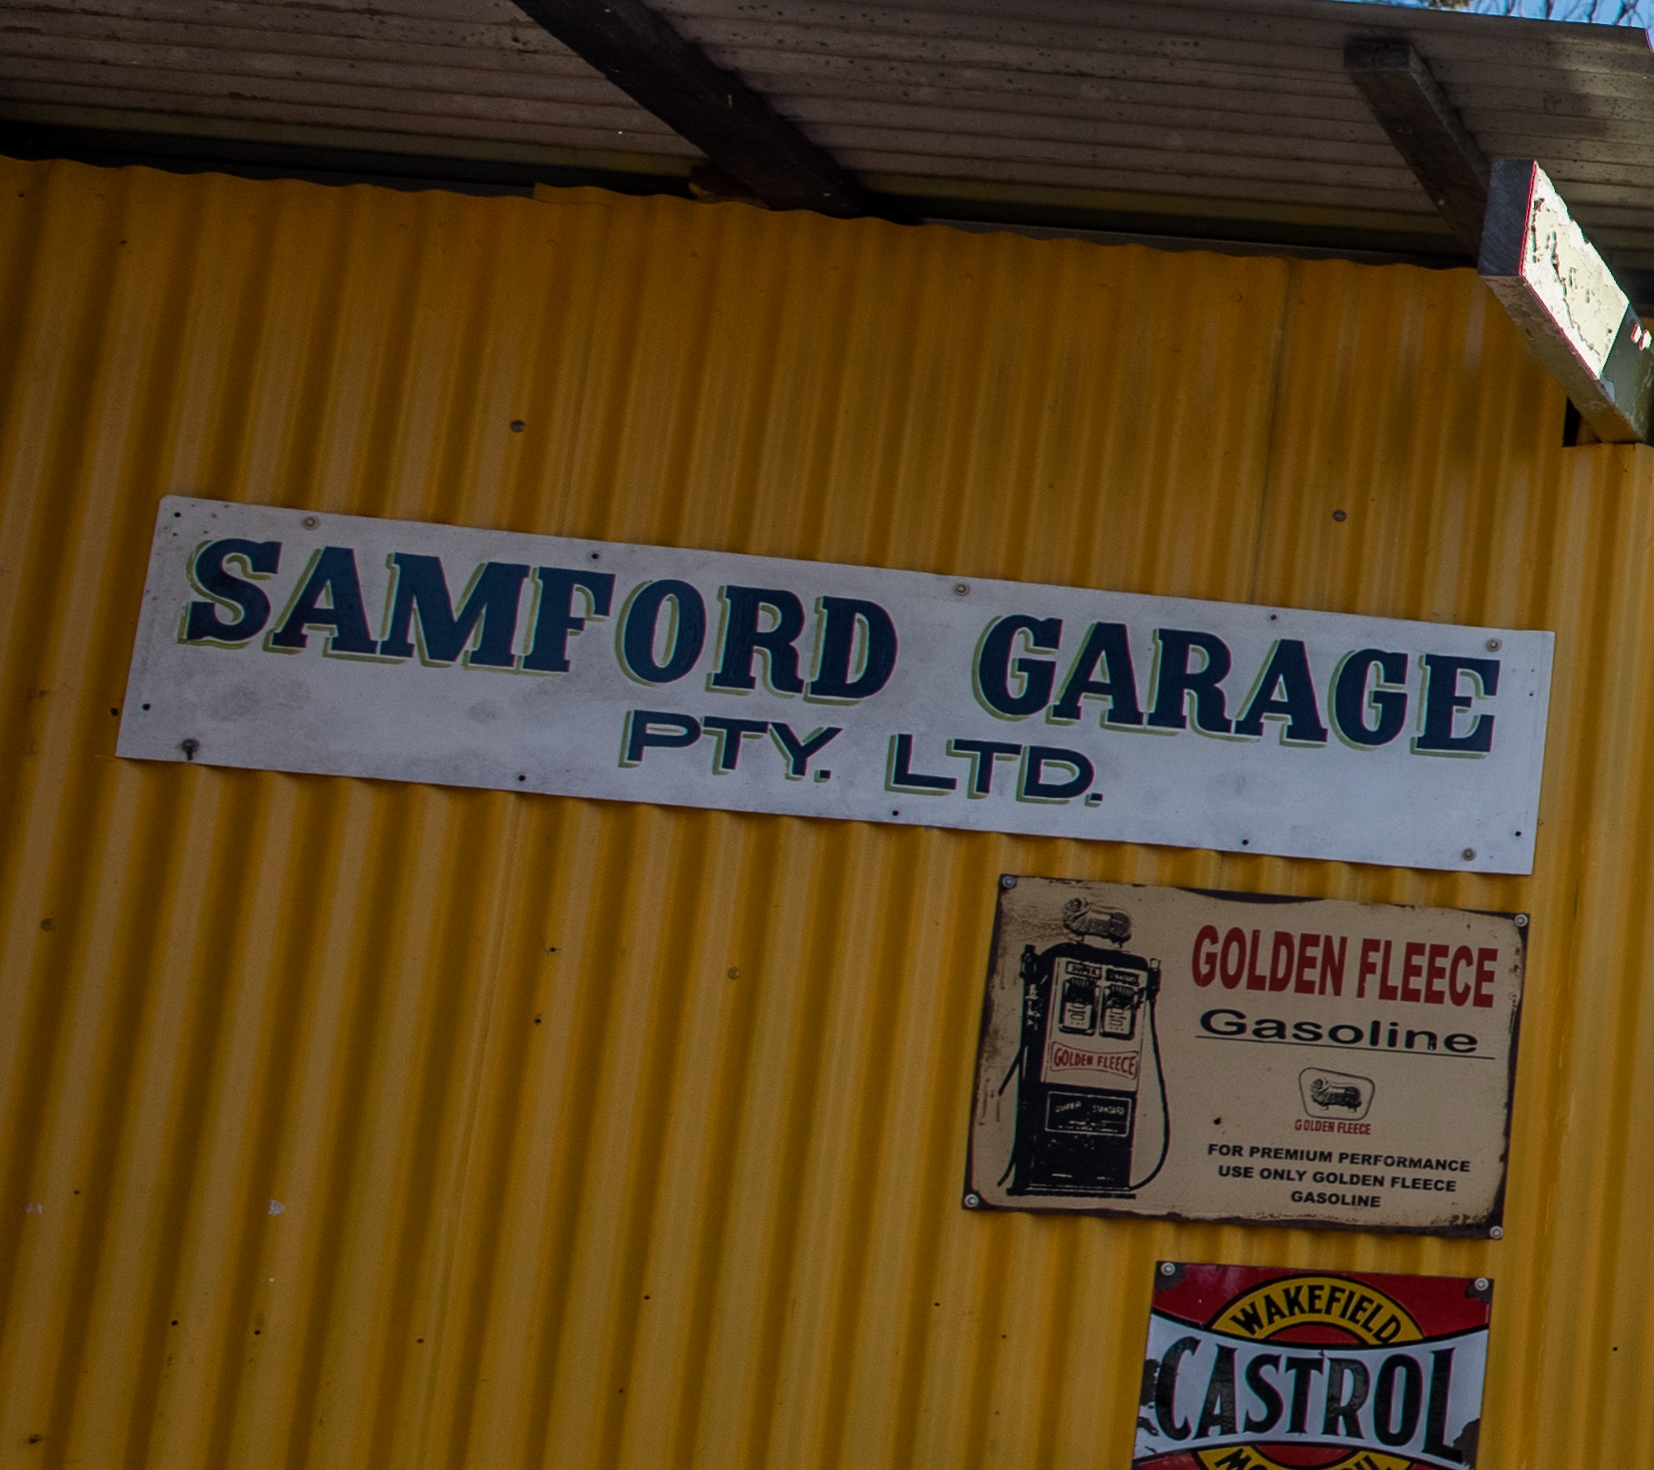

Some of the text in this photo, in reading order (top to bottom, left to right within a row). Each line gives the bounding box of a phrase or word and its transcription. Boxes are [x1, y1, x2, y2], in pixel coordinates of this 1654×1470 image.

[178, 534, 1501, 758] SAMFORD GARAGE
[620, 708, 1105, 806] PTY. LTD.
[1192, 924, 1499, 1009] GOLDEN FLEECE
[1200, 1009, 1479, 1054] Gasoline
[1054, 1047, 1136, 1076] GOLDEN FLEECE
[1294, 1118, 1372, 1136] GOLDEN FLEECE
[1207, 1143, 1471, 1173] FOR PREMIUM PERFORMANCE
[1218, 1165, 1457, 1193] USE ONLY GOLDEN FLEECE
[1290, 1190, 1381, 1209] GASOLINE
[1229, 1283, 1402, 1345] WAKEFIELD
[1154, 1335, 1464, 1465] CASTROL
